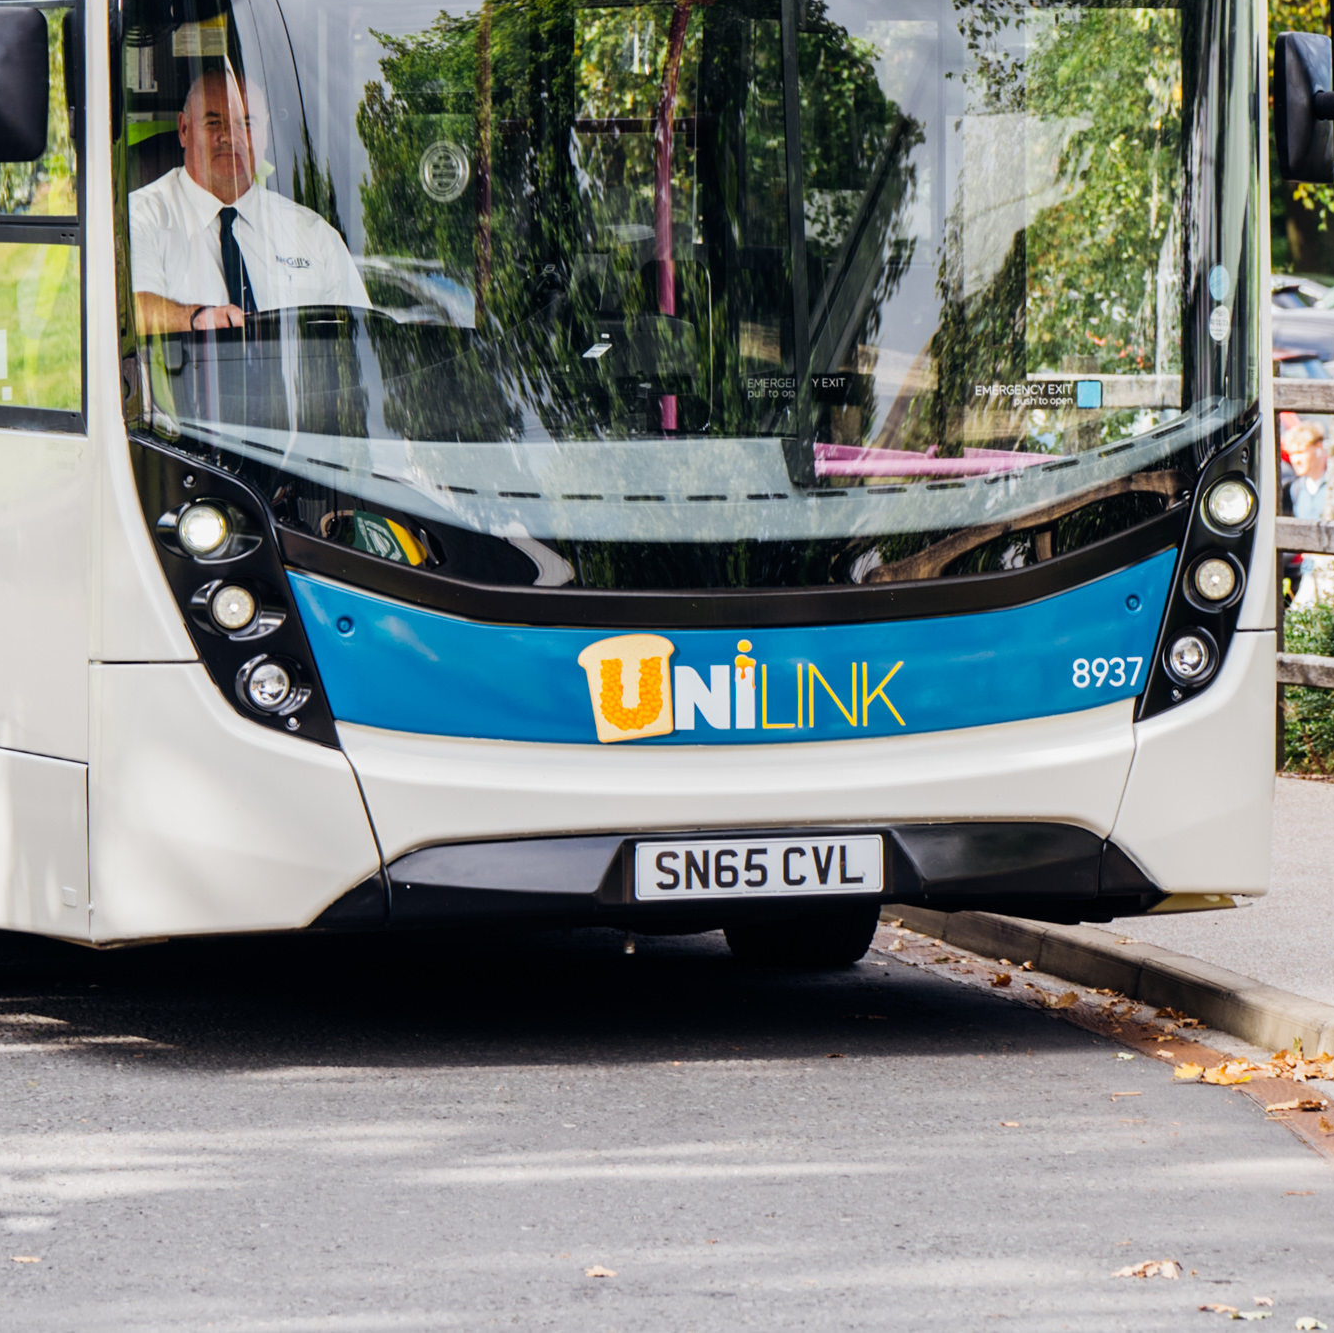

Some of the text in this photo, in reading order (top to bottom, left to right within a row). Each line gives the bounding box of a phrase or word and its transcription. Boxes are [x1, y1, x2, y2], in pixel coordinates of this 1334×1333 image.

[821, 377, 847, 388] EXIT
[747, 388, 766, 401] pull
[768, 389, 779, 399] to
[975, 383, 1073, 397] EMERGENCY EXIT
[1013, 396, 1074, 408] push to open
[1071, 656, 1144, 689] 8937
[655, 844, 864, 891] SN65 CVL
